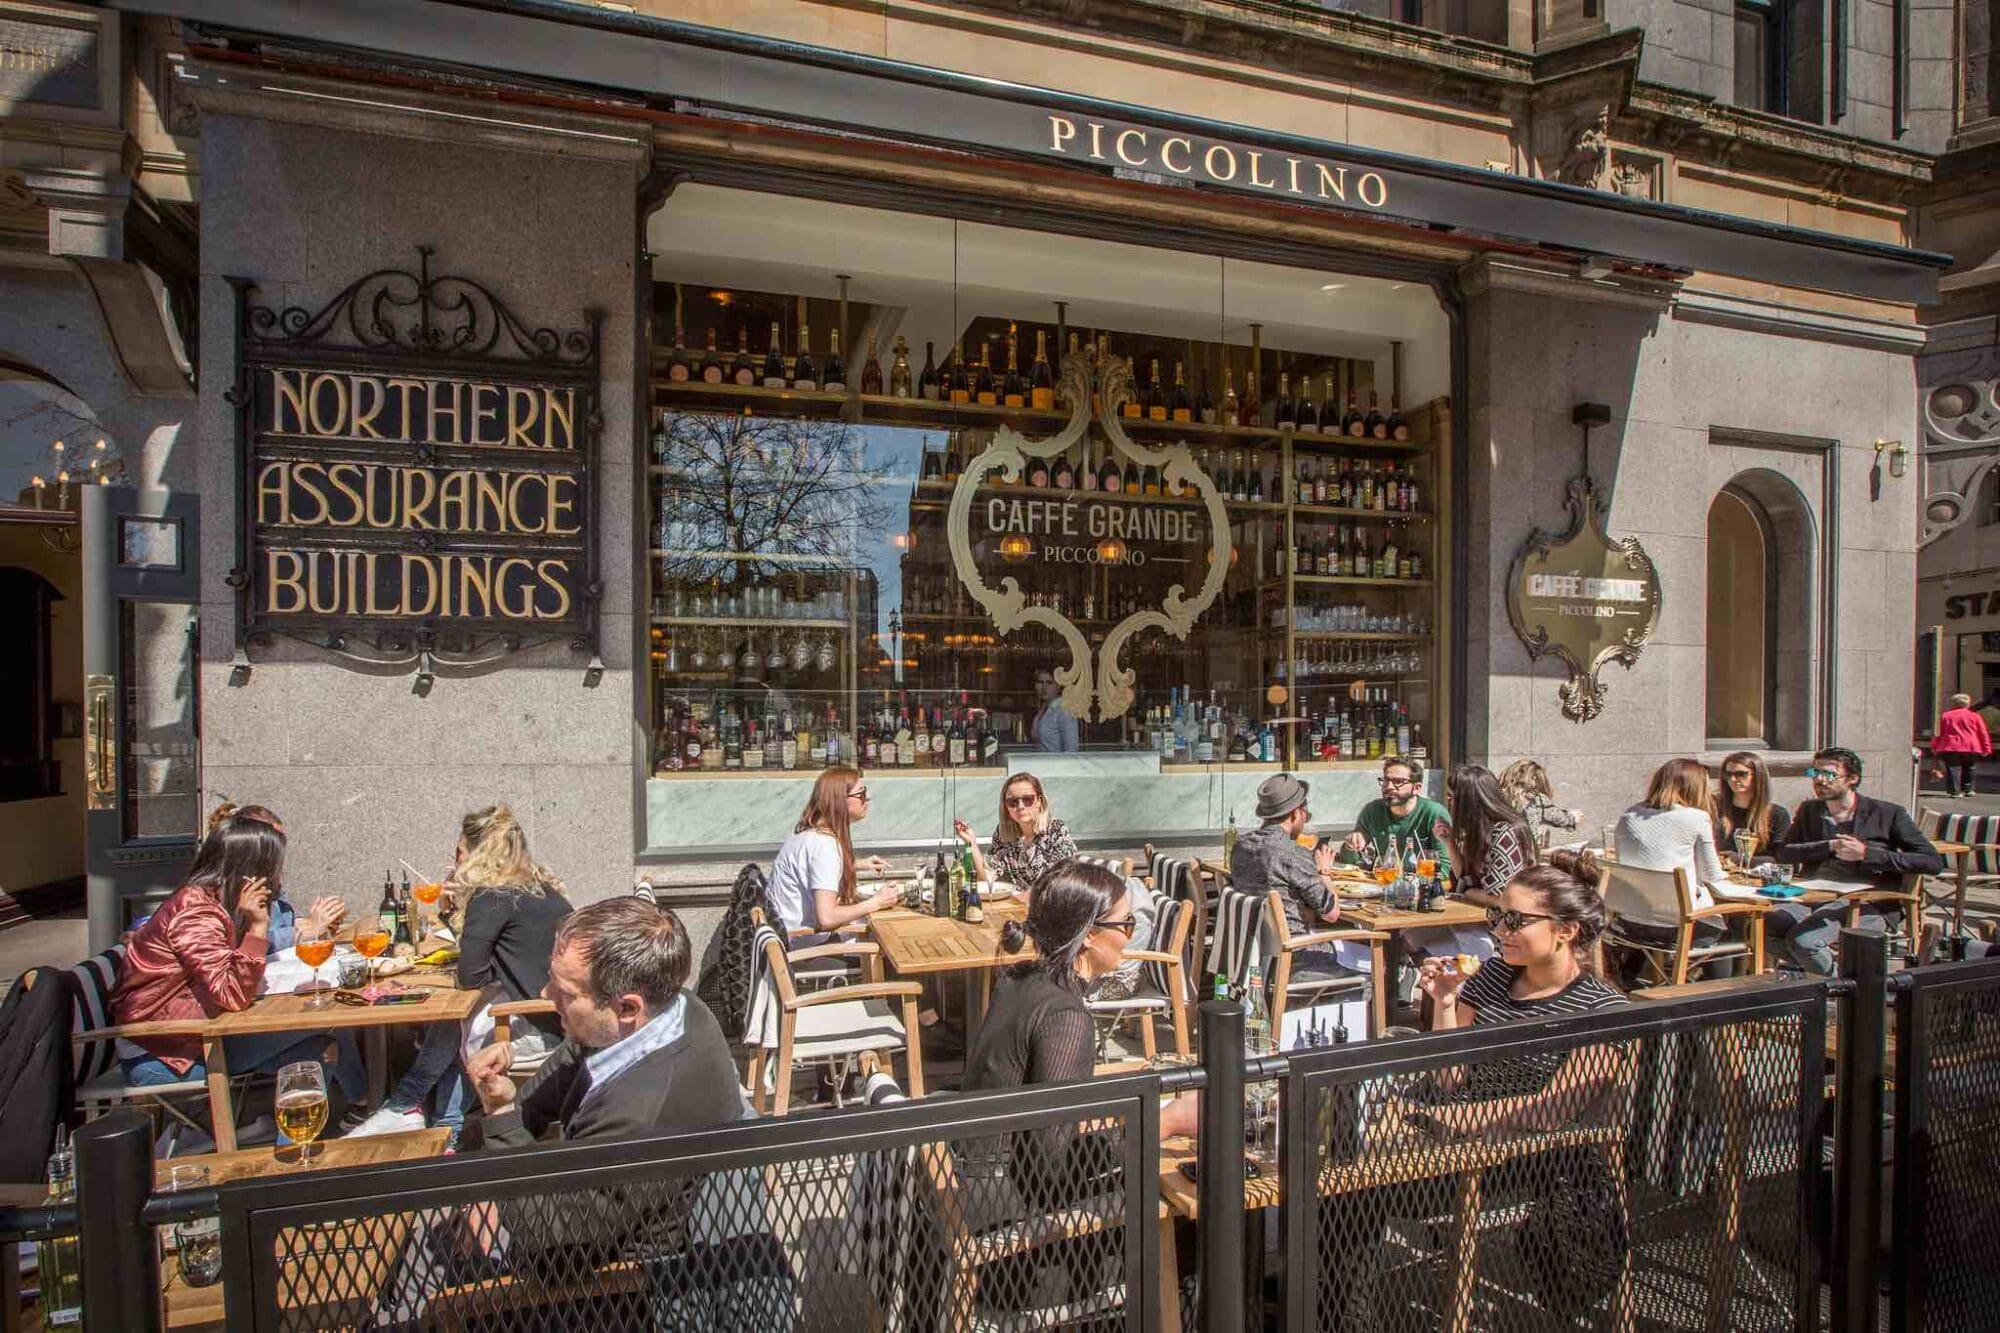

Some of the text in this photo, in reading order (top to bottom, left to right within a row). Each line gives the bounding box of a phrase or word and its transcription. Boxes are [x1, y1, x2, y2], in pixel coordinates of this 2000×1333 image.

[1048, 116, 1387, 207] PICCOLINO
[272, 369, 576, 450] NORTHERN
[257, 461, 582, 535] ASSURANCE
[1088, 504, 1199, 543] GRANDE
[265, 550, 571, 619] BUILDINGS
